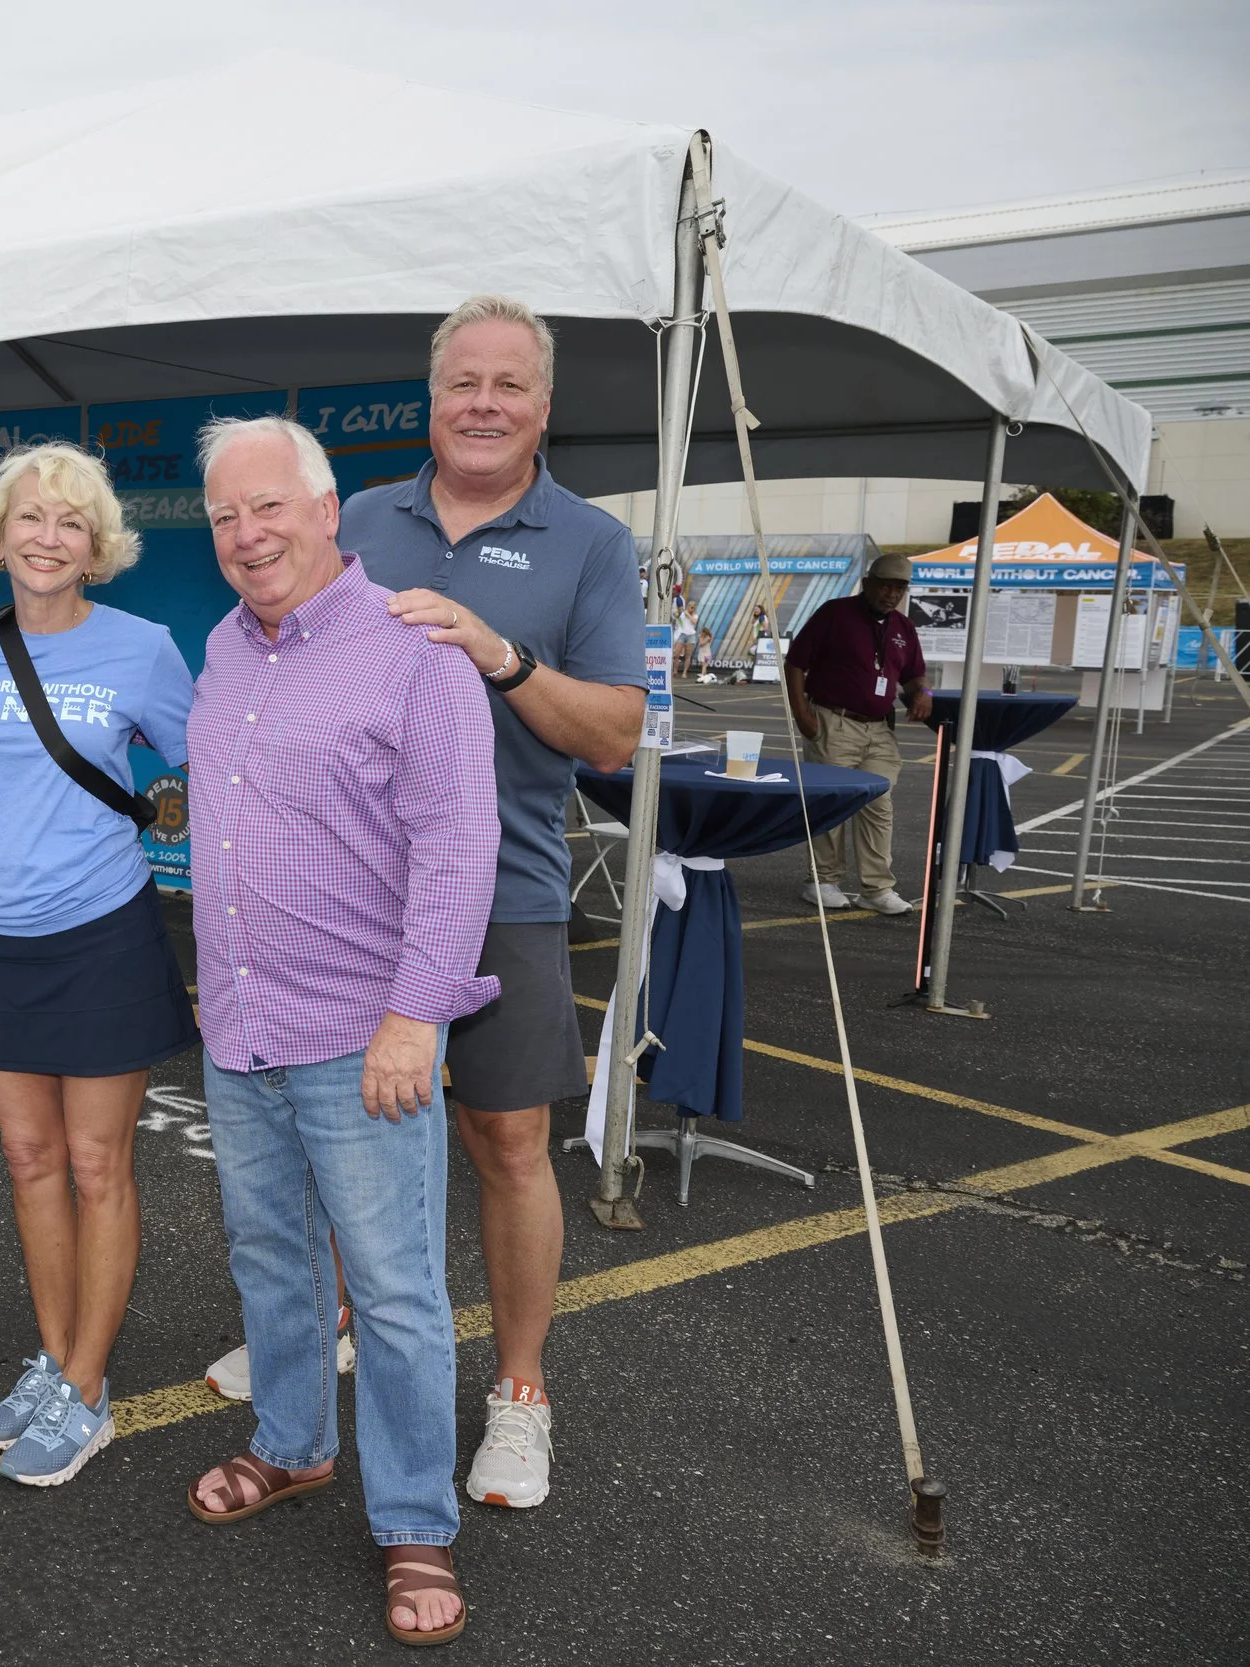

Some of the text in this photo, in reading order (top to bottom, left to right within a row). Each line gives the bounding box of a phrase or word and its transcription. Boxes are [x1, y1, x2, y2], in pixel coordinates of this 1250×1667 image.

[313, 401, 422, 433] I GIVE
[114, 453, 182, 481] AISE
[480, 546, 530, 564] PEDAL
[706, 561, 741, 570] WORLD
[745, 560, 793, 570] WITOUT
[917, 567, 974, 578] WORLD
[40, 682, 117, 702] WITHOUT
[147, 779, 183, 800] PEDAL
[158, 798, 182, 827] 15
[158, 851, 187, 863] 100%
